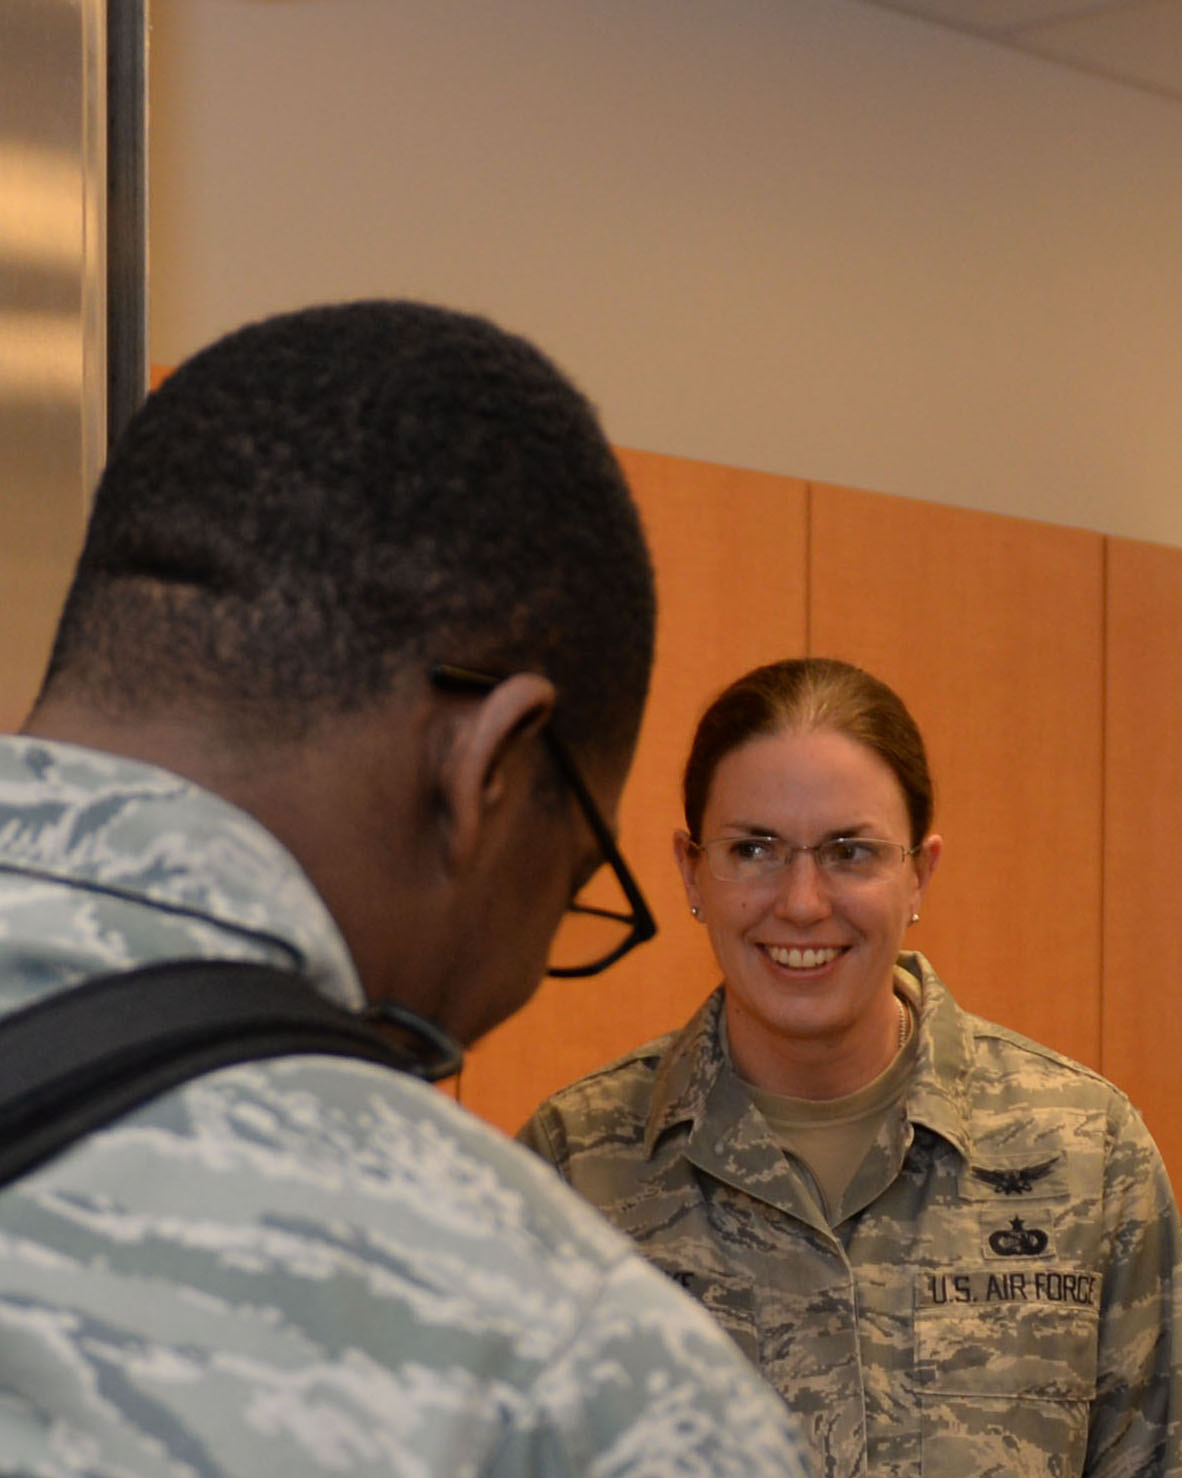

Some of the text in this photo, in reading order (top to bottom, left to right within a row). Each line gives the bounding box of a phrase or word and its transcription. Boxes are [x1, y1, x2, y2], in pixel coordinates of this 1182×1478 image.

[931, 1272, 1097, 1306] U.S. AIR FORCE
